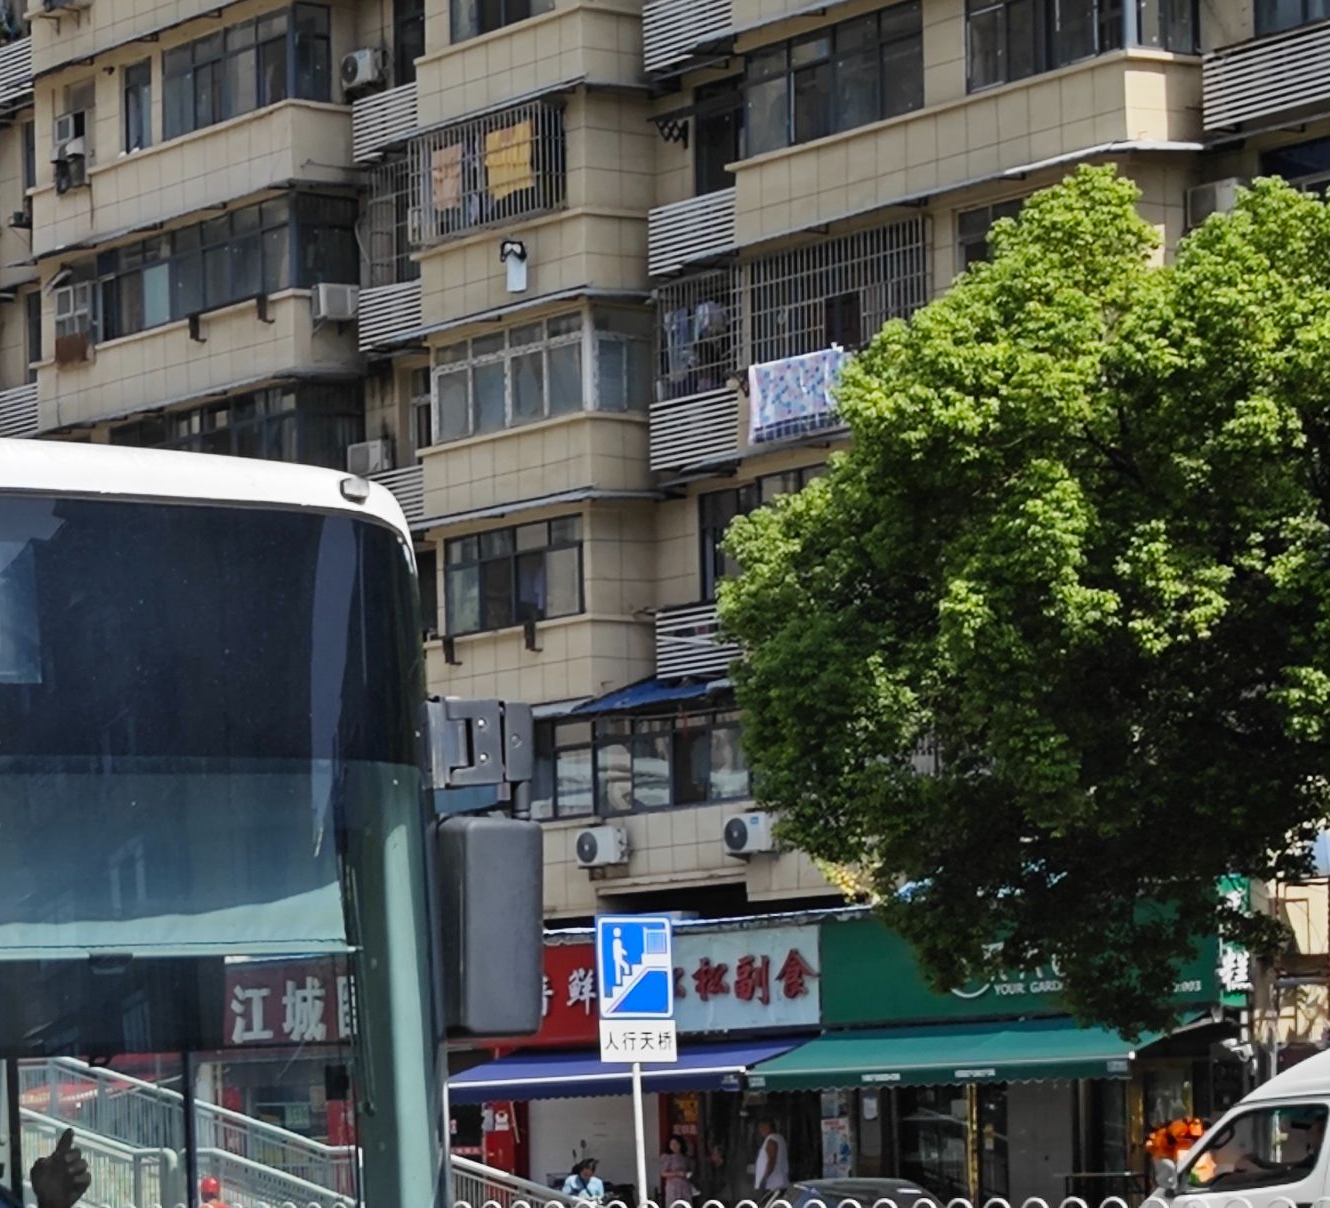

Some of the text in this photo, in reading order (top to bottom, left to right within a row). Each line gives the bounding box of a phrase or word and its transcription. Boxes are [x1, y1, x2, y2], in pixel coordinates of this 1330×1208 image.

[994, 983, 1026, 995] YOUR
[605, 1031, 673, 1051] 人行天桥
